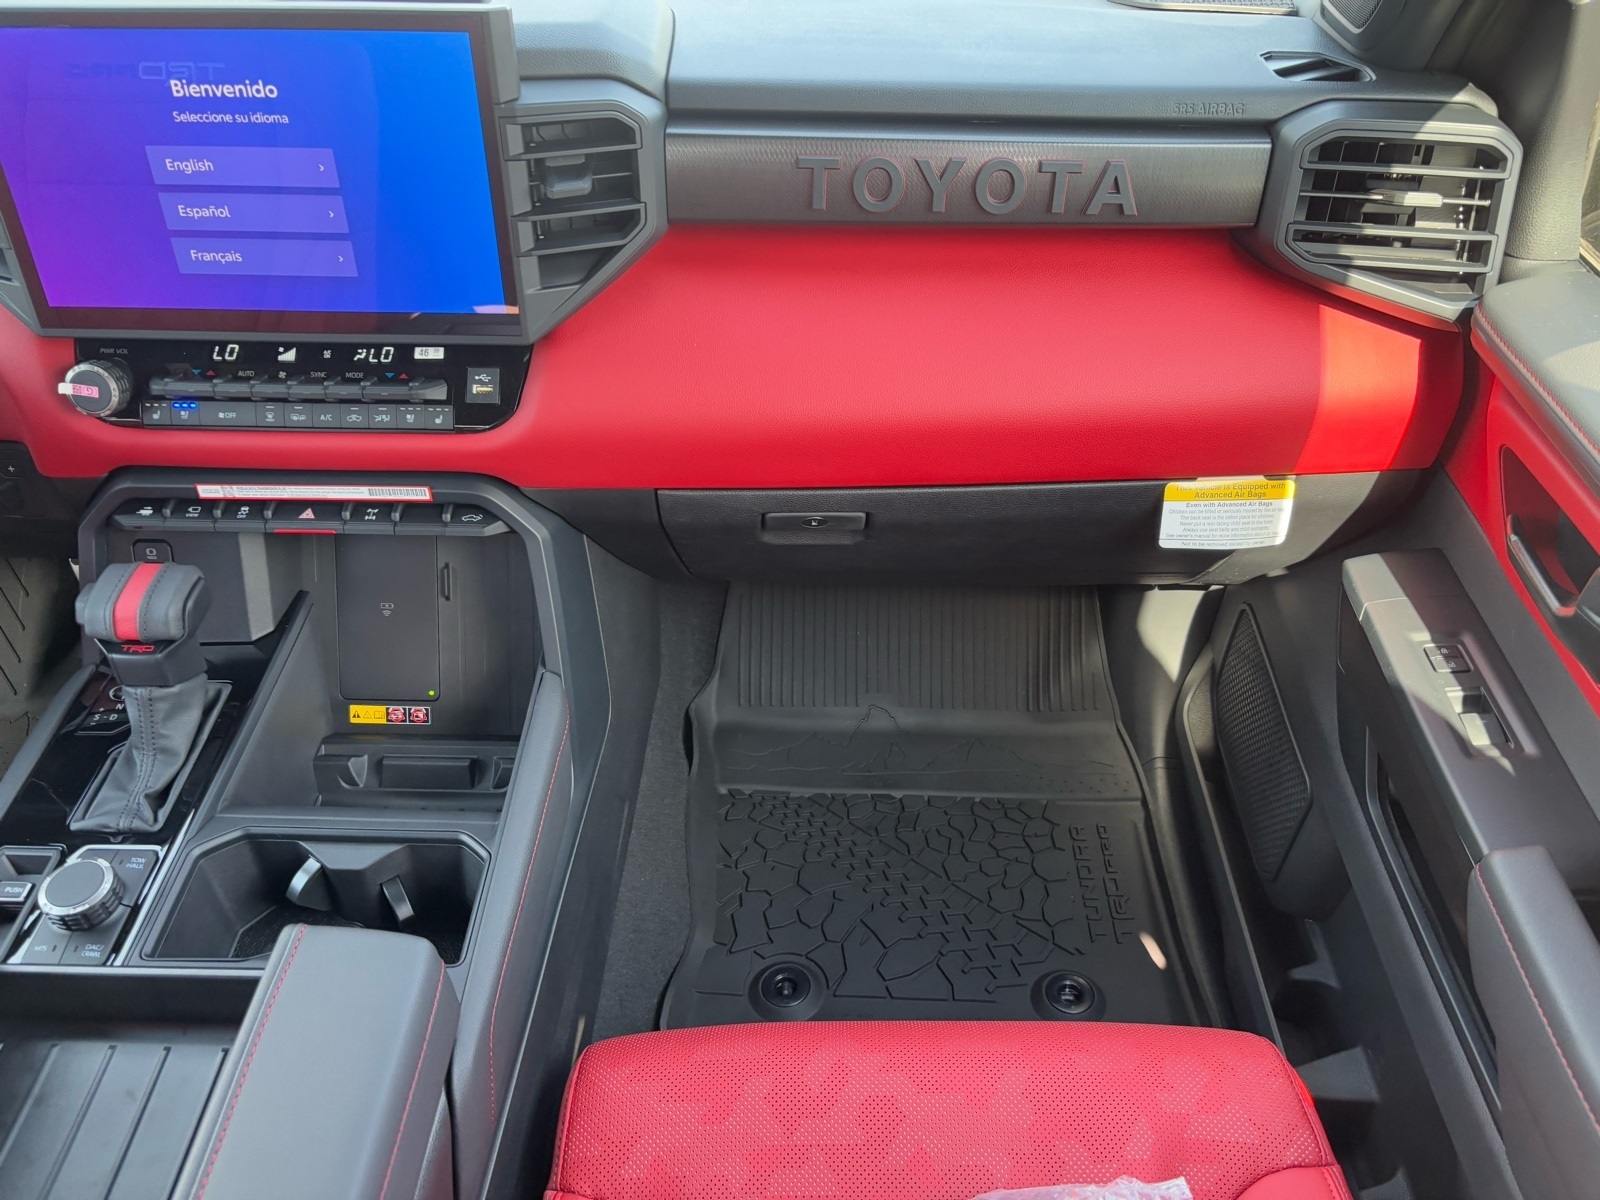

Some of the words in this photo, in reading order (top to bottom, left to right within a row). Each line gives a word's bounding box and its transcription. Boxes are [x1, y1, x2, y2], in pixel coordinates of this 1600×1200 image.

[169, 79, 278, 99] Bienvenido
[1172, 102, 1196, 116] SRS
[1197, 103, 1246, 117] AIRBAG
[173, 111, 233, 124] Seleccione
[235, 114, 249, 124] su
[250, 112, 289, 125] idioma
[165, 158, 214, 175] English
[796, 153, 1138, 217] TOYOTA
[178, 205, 231, 221] Español
[190, 249, 243, 265] Français
[212, 344, 240, 361] LO
[369, 347, 395, 363] LO
[418, 349, 430, 357] 46
[1233, 483, 1269, 492] Equipped
[1248, 491, 1266, 499] Bags
[121, 645, 155, 653] TRD
[1069, 823, 1107, 943] TUNDRA
[1103, 876, 1135, 944] TRD
